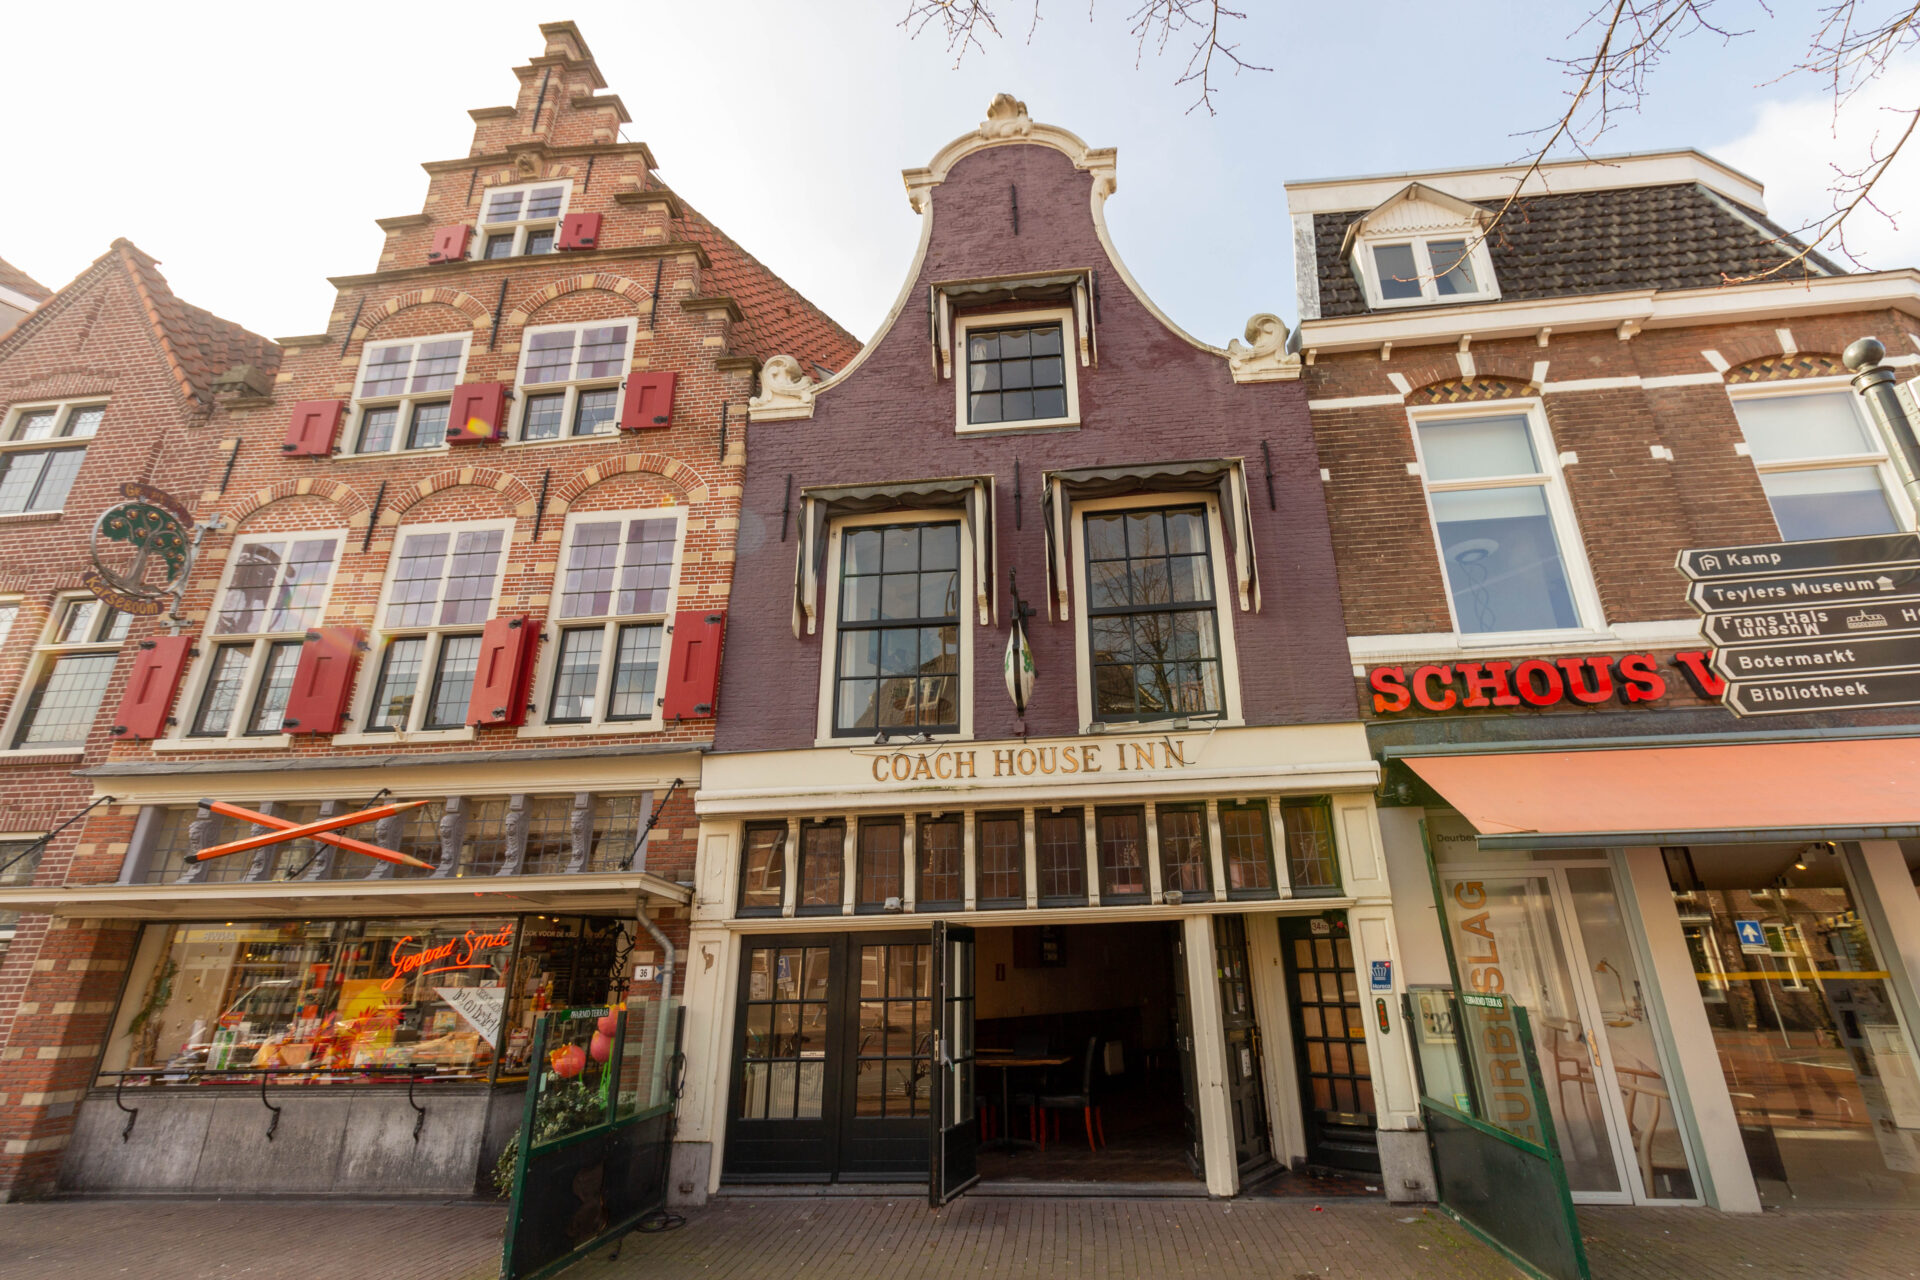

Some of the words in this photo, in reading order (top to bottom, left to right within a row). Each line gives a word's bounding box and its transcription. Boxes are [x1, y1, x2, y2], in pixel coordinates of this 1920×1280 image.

[1726, 552, 1782, 567] Kamp
[1713, 584, 1787, 602] Teylers
[1792, 579, 1875, 596] Museum
[1721, 615, 1778, 629] Frans
[1783, 610, 1828, 625] Hals
[1738, 649, 1856, 669] Botermarkt
[1369, 653, 1667, 713] SCHOUS
[1750, 682, 1870, 702] Bibliotheek
[872, 751, 977, 781] COACH
[992, 745, 1103, 777] HOUSE
[1116, 740, 1186, 770] INN
[380, 935, 457, 992] Gerard
[456, 923, 513, 965] Smit
[640, 968, 648, 978] 36
